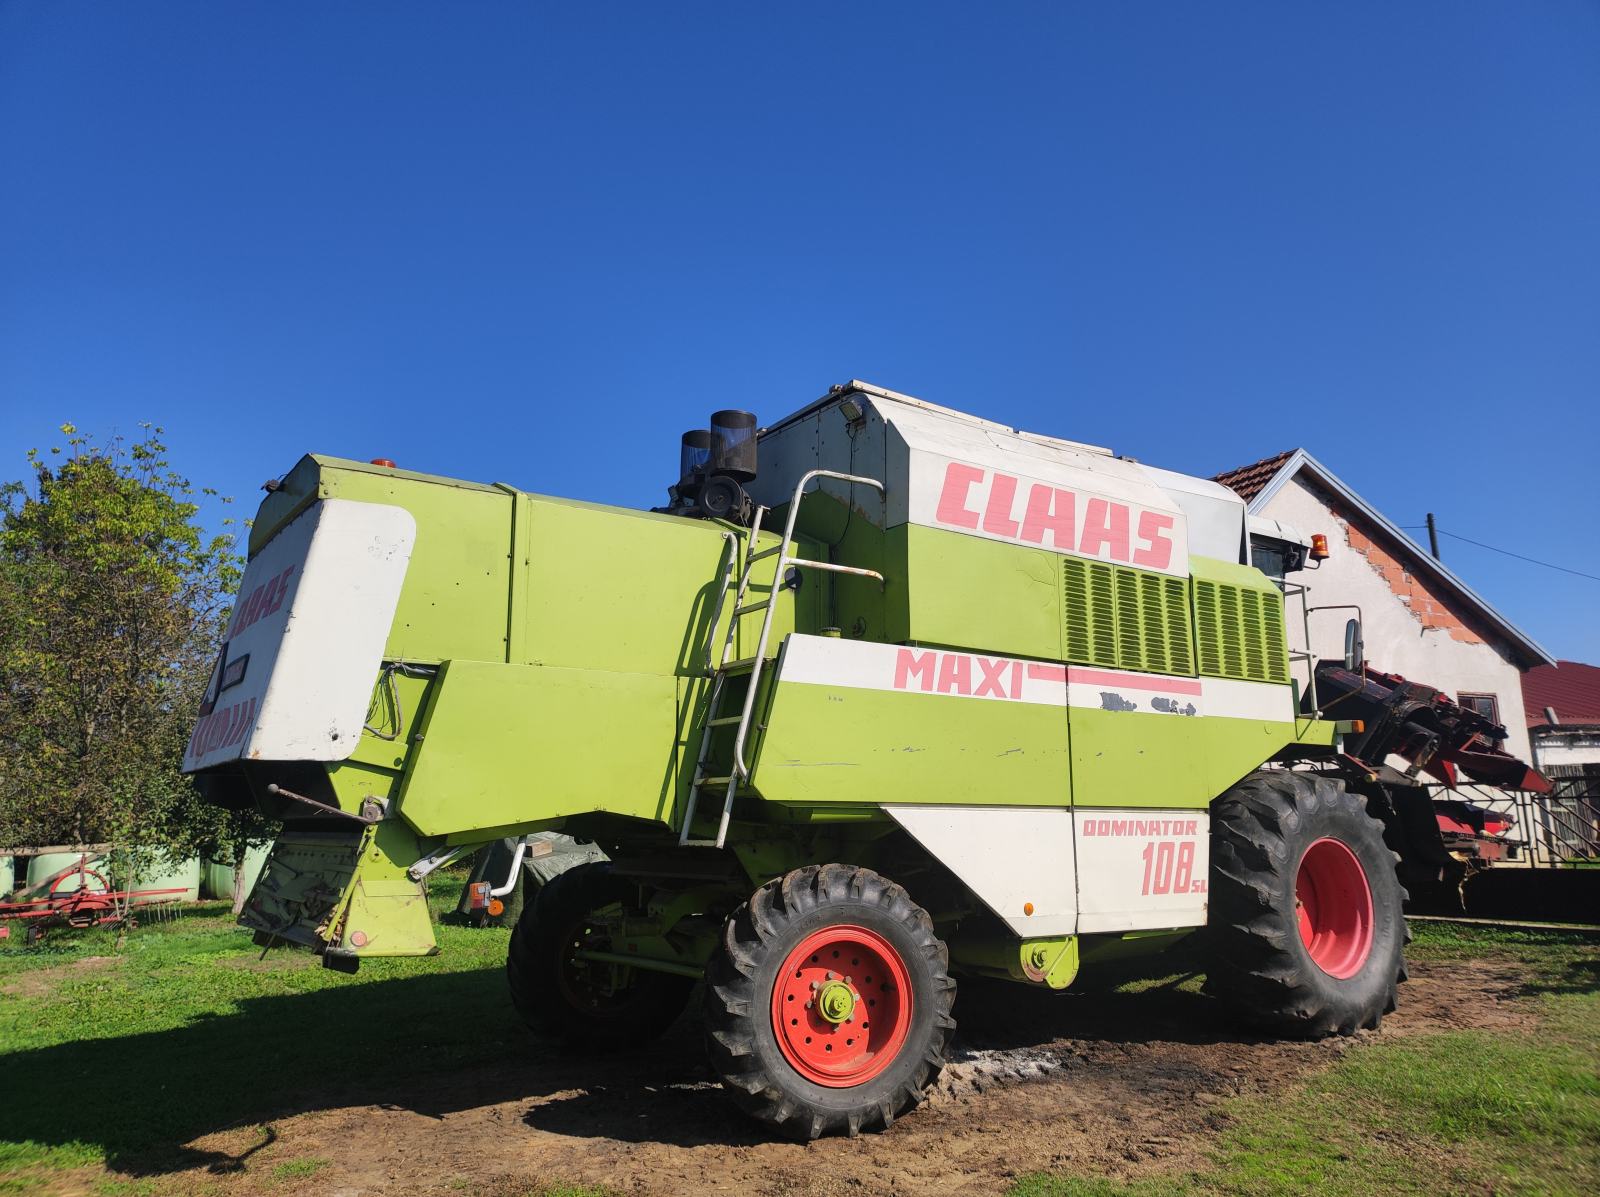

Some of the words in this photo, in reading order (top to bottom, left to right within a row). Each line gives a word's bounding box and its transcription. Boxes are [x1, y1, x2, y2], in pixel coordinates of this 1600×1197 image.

[936, 462, 1174, 569] CLAAS
[894, 648, 1023, 700] MAXI
[1083, 820, 1198, 836] DOMINATOR
[1142, 841, 1195, 896] 108
